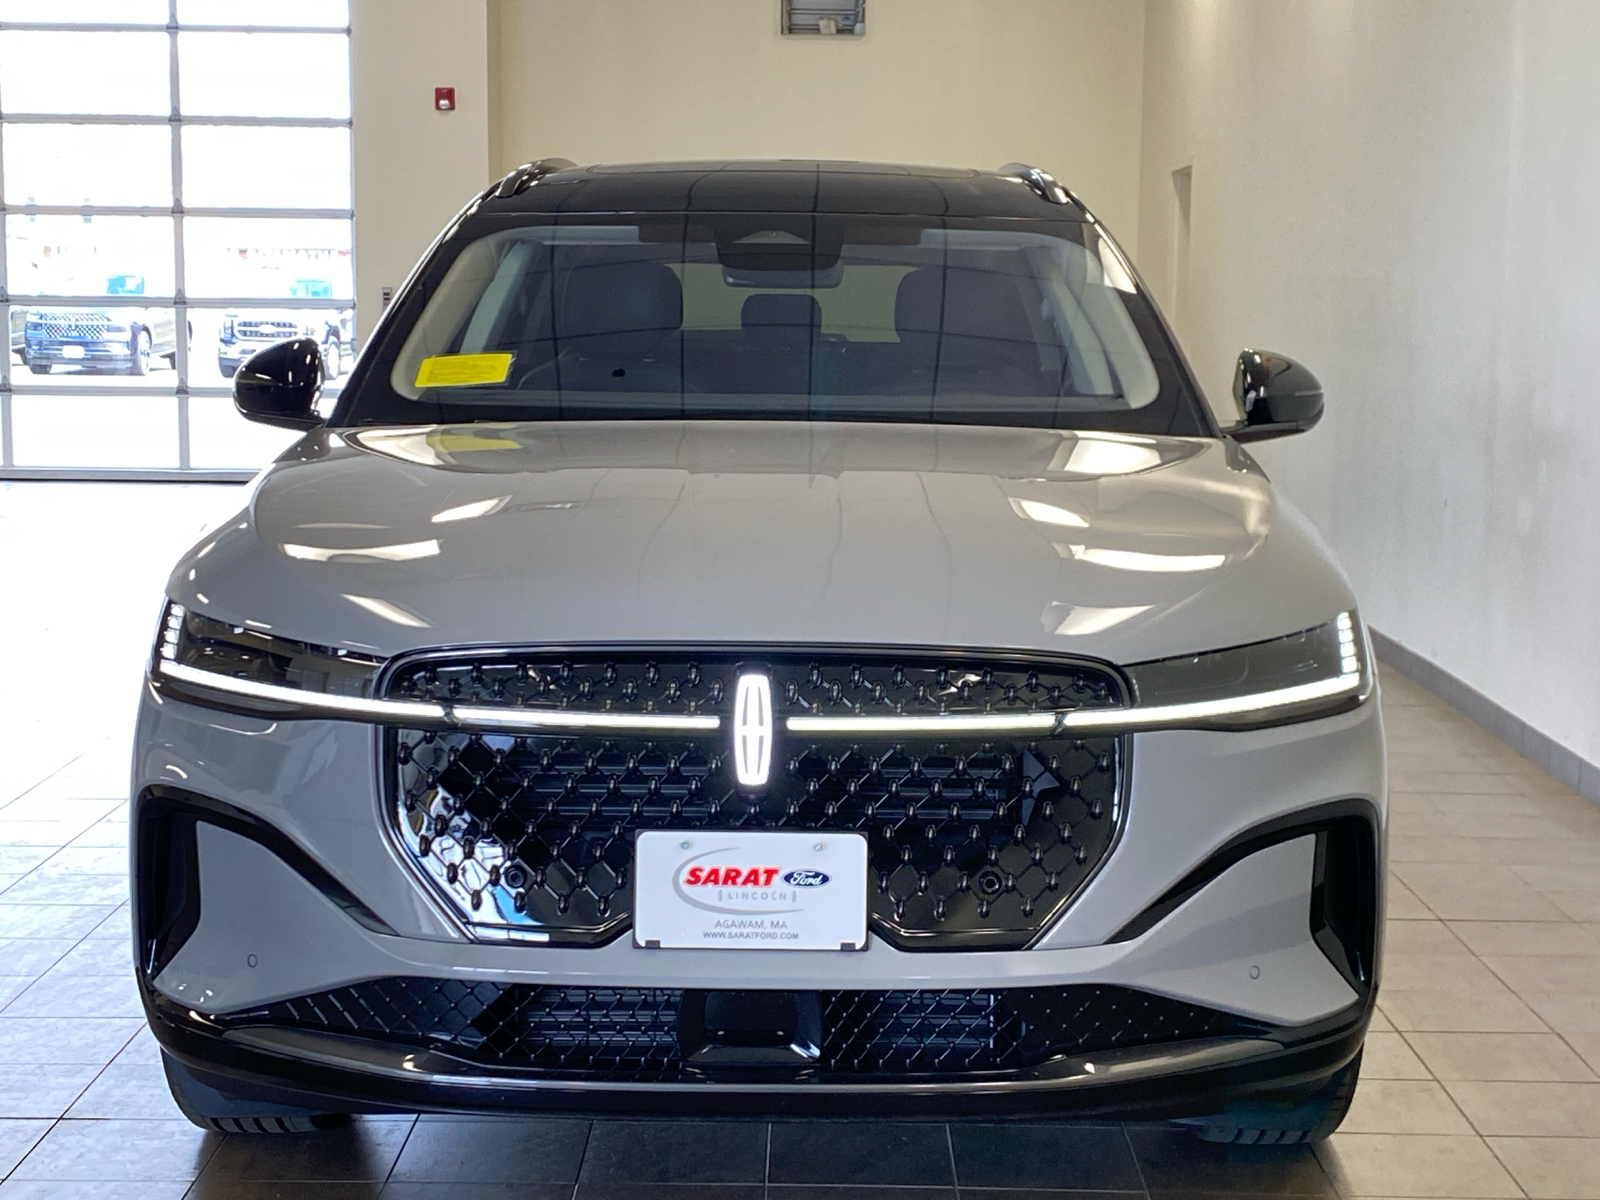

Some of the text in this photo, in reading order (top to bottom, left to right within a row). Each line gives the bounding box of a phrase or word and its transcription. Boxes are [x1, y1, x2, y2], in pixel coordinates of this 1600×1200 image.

[684, 867, 824, 886] SARAT Ford
[728, 891, 787, 900] LINCOLN
[715, 919, 788, 930] AGAWAM, MA
[703, 931, 799, 940] WWW.SARATFORD.COM
